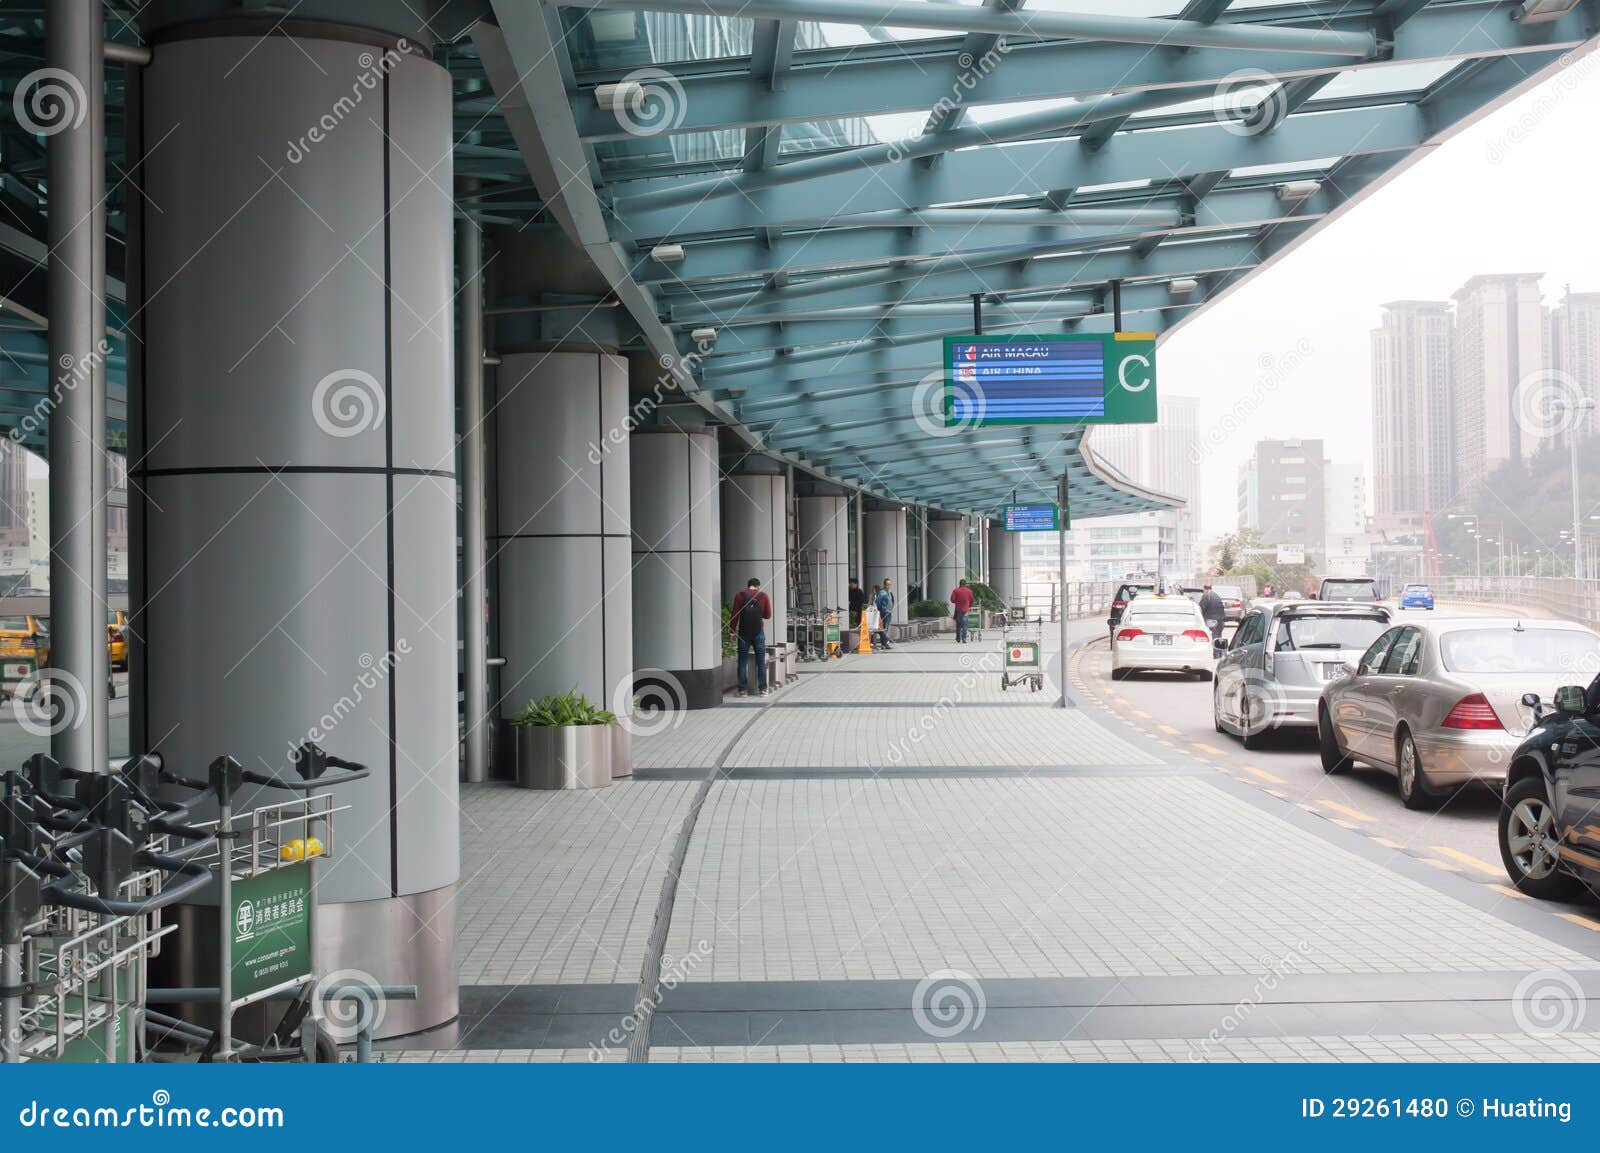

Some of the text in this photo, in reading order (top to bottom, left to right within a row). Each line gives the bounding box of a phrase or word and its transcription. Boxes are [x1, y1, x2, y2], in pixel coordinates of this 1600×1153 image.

[981, 346, 1049, 358] AIR MACAU
[1118, 354, 1150, 393] C
